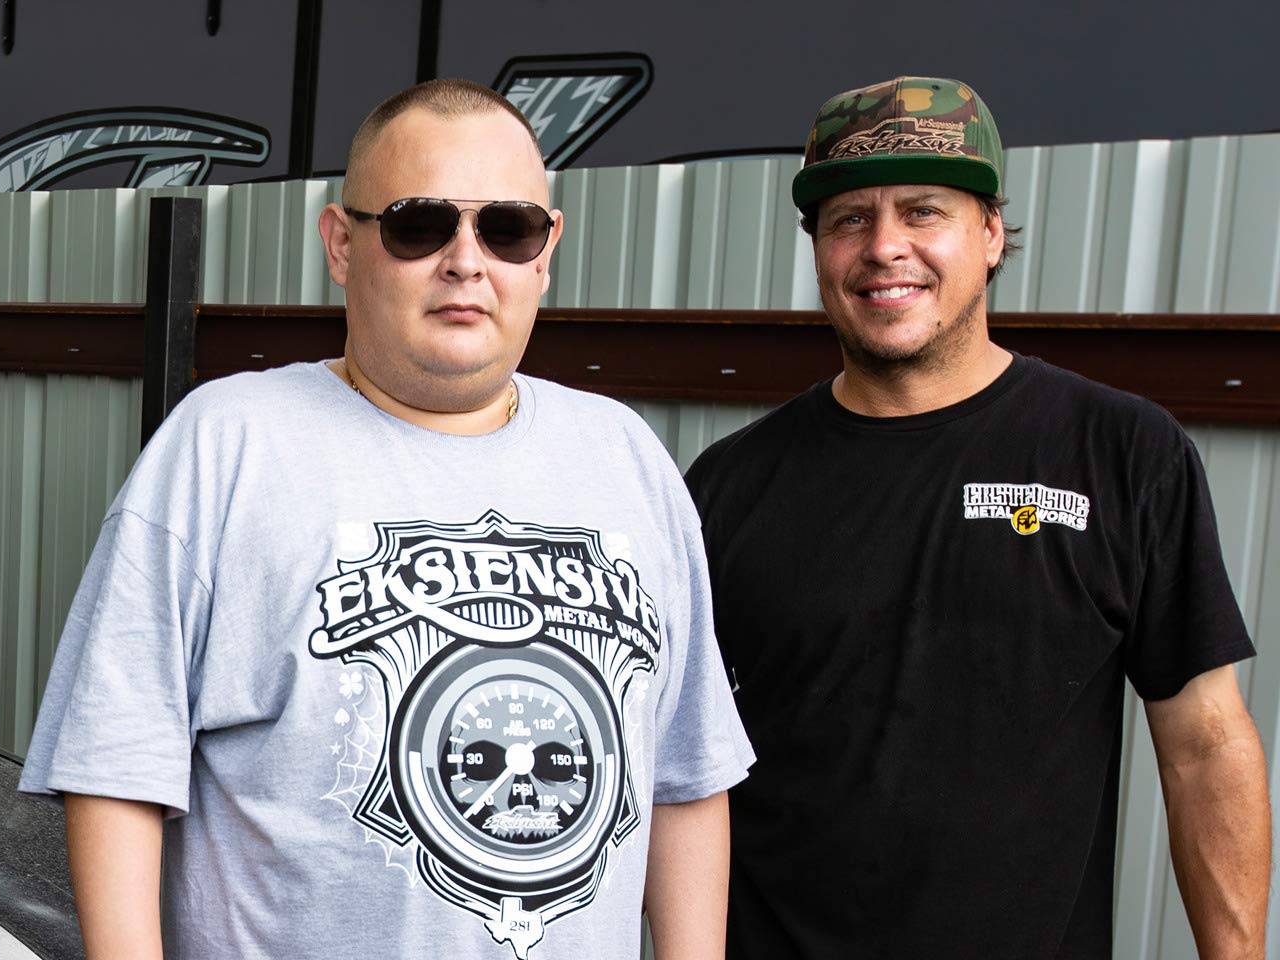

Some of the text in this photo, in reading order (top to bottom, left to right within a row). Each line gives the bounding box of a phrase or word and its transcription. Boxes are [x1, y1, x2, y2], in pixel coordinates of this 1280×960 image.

[966, 505, 1087, 531] METAL WORKS
[543, 604, 613, 634] METAL
[532, 718, 556, 731] 120
[466, 752, 484, 765] 30
[550, 754, 572, 766] 150
[512, 783, 534, 797] PSI
[536, 795, 559, 807] 180
[509, 920, 530, 931] 281
